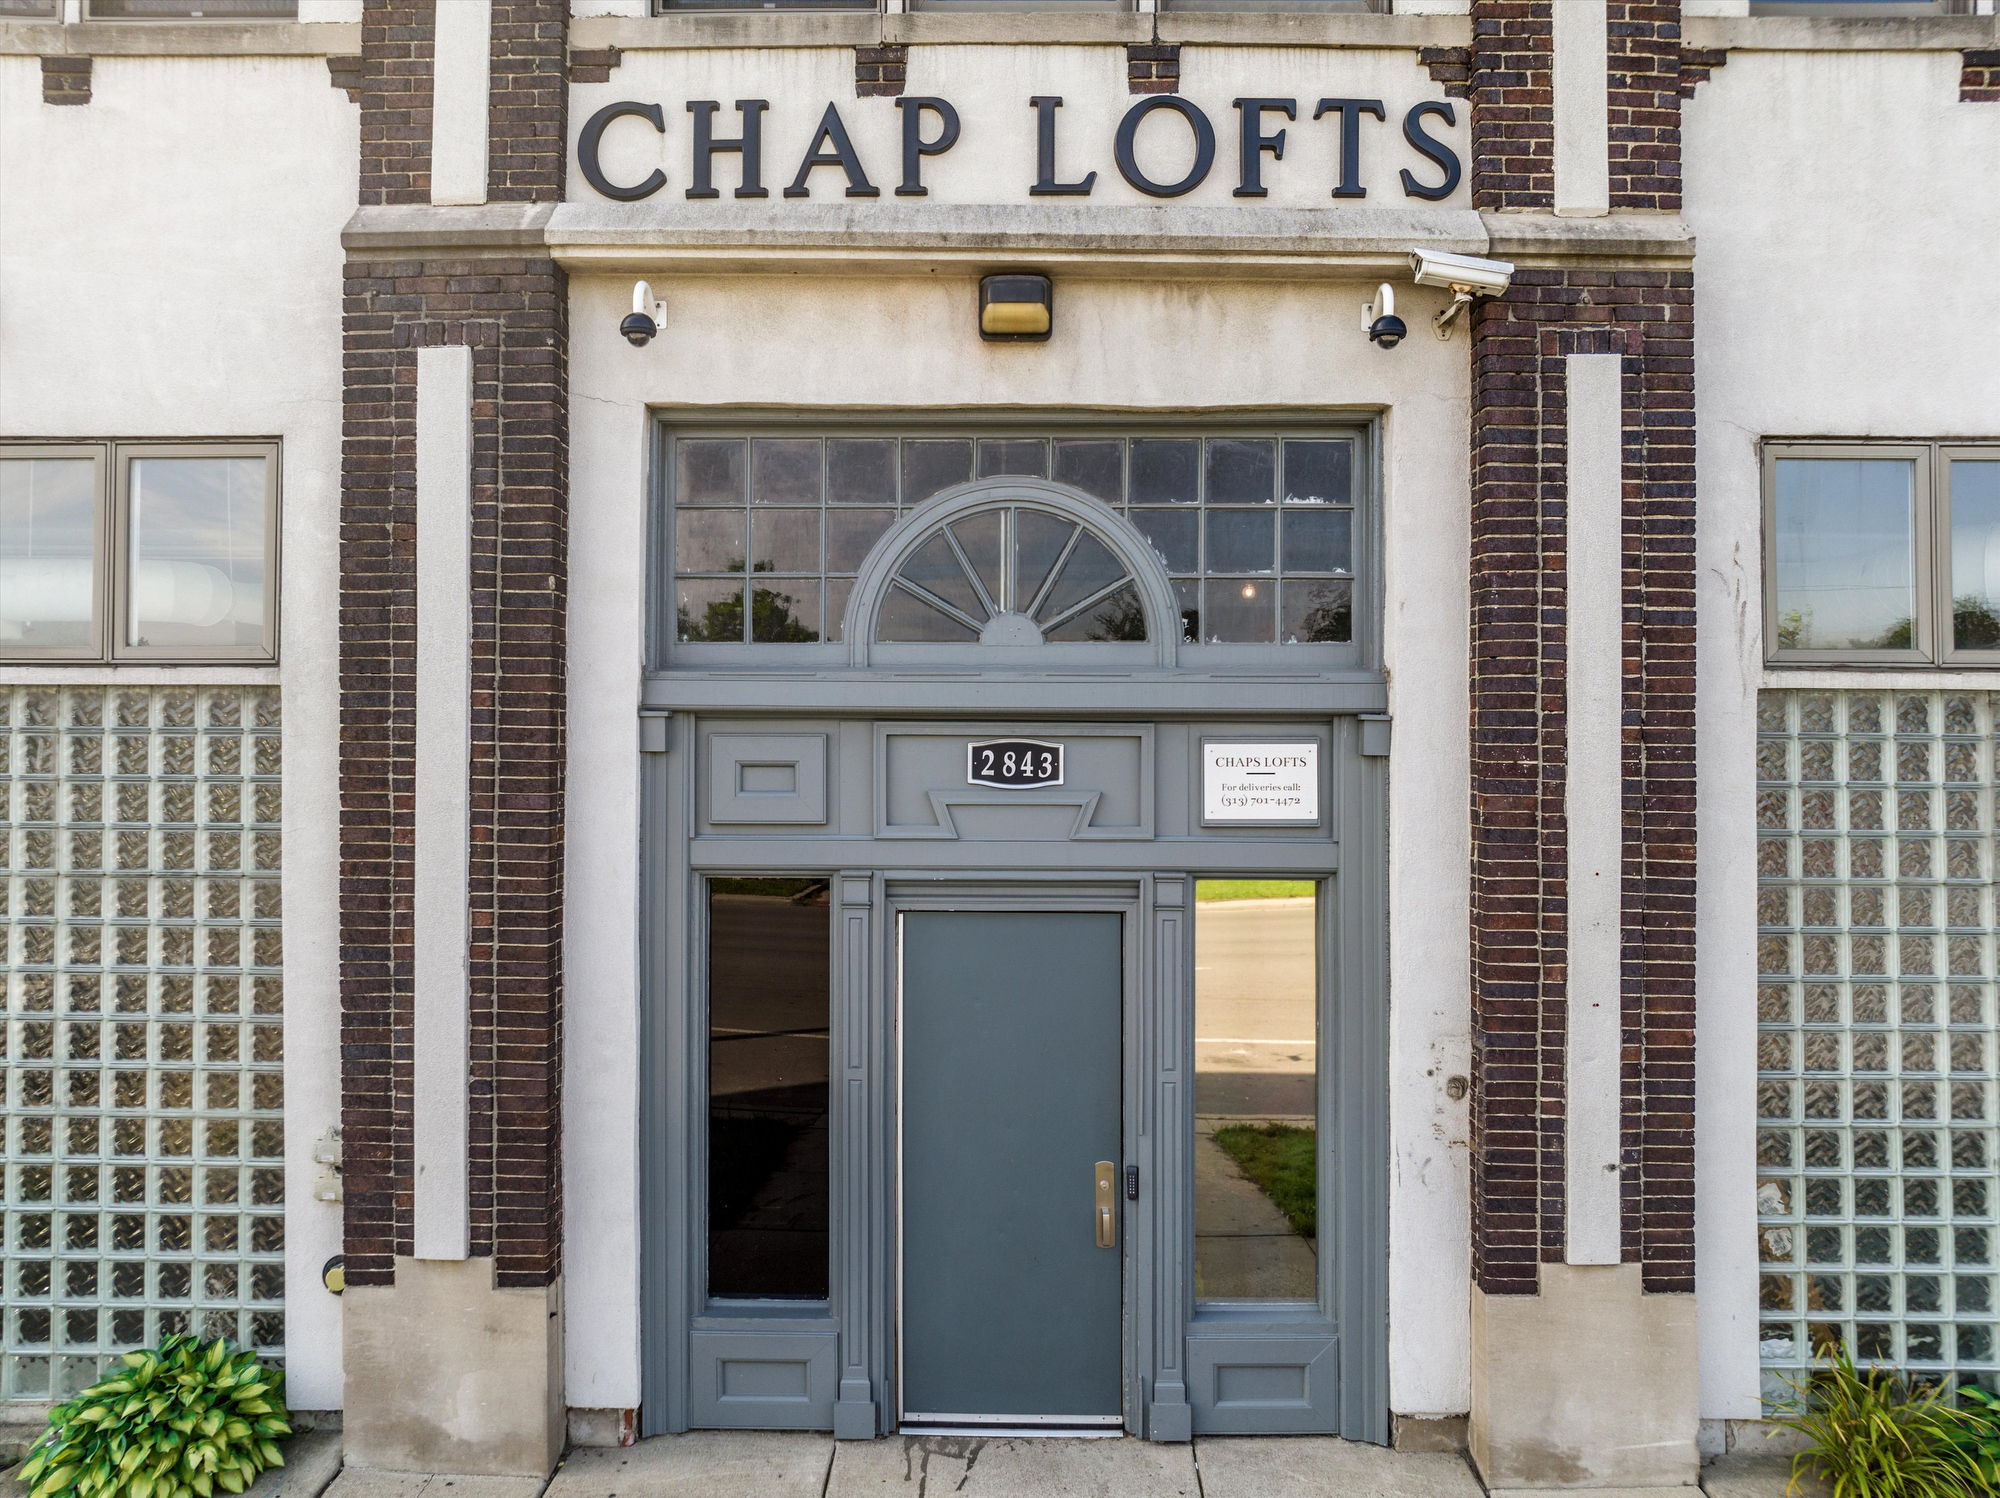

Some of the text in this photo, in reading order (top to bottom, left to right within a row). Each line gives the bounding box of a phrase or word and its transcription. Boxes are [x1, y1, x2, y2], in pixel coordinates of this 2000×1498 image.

[577, 94, 1462, 201] CHAP LOFTS
[981, 750, 1052, 778] 2843
[1215, 757, 1307, 767] CHAPS LOFTS
[1222, 783, 1300, 791] For deliveries call:
[1221, 794, 1301, 806] (313) 701-4472
